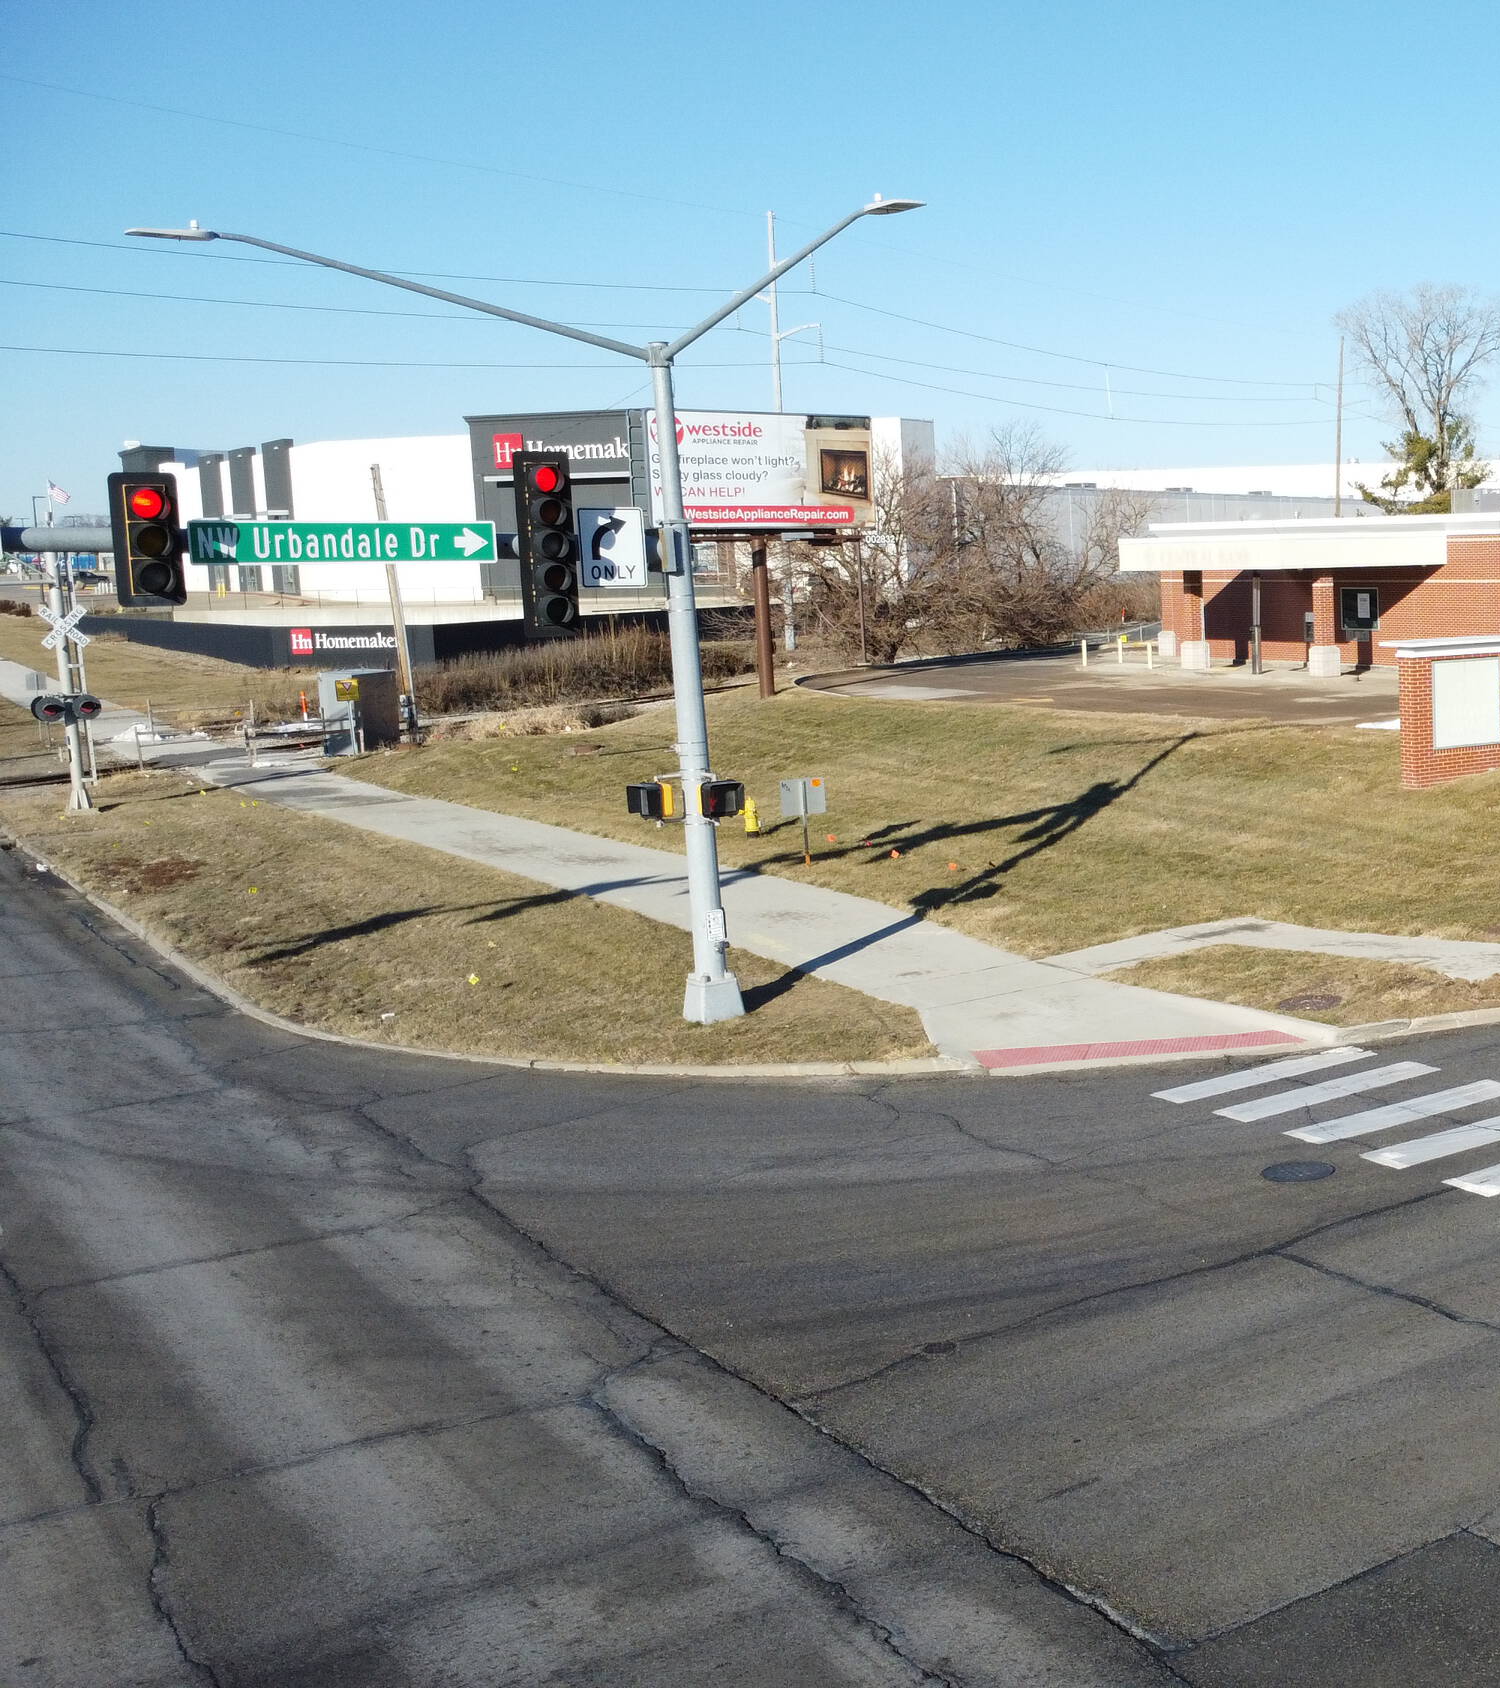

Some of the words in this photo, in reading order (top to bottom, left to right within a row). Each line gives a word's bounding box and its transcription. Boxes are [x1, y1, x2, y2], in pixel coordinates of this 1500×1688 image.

[688, 422, 763, 438] westside
[526, 437, 629, 460] Hmemak
[733, 438, 758, 446] REPAIR
[731, 455, 762, 466] won't
[765, 455, 795, 468] light?
[692, 470, 722, 482] glass
[725, 470, 768, 482] cloudy?
[709, 487, 745, 498] HELP!
[684, 508, 849, 521] WestsideApplianceRepair.com
[198, 527, 238, 559] NW
[253, 527, 399, 559] Urbandale
[410, 527, 440, 558] Dr
[865, 535, 895, 544] 002832
[591, 565, 636, 580] ONLY
[314, 632, 400, 649] Homemaker
